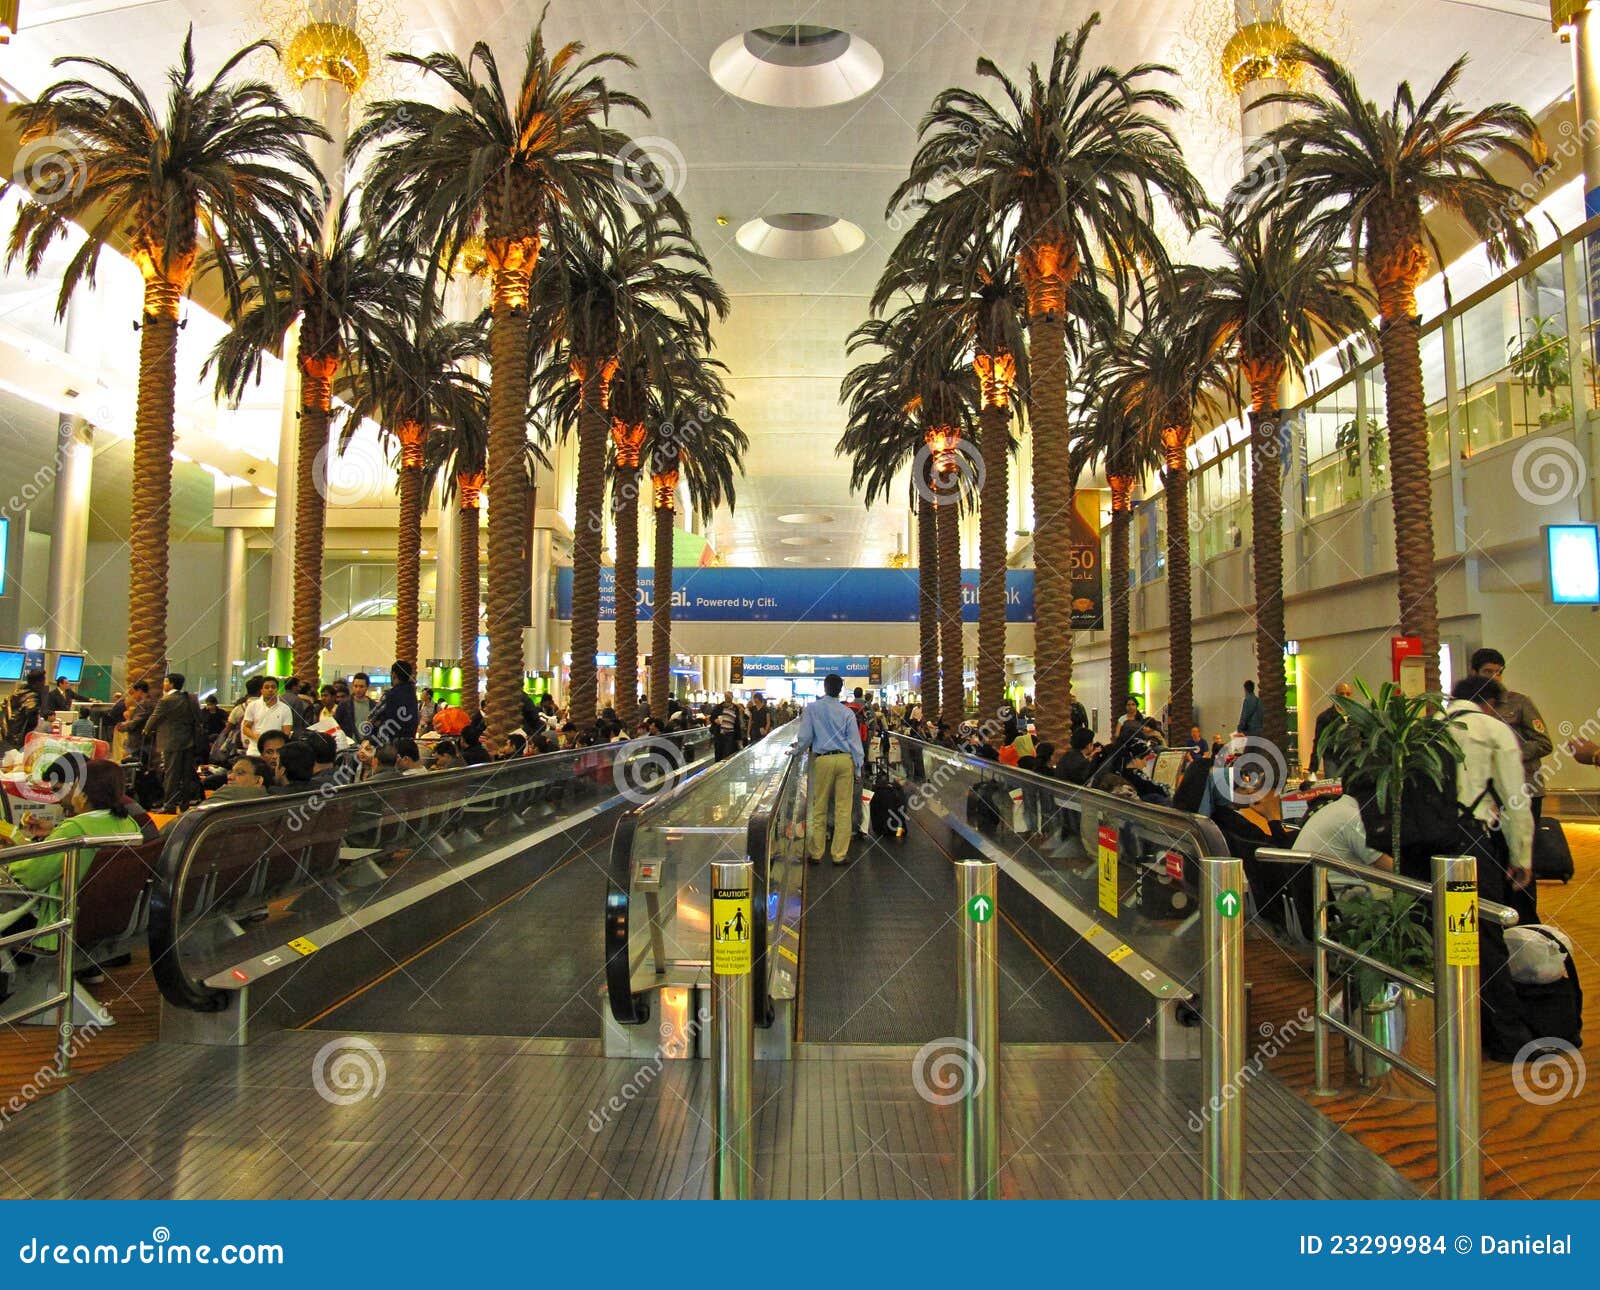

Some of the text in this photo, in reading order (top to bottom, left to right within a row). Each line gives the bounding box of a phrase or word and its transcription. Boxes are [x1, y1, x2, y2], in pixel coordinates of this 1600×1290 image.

[697, 598, 739, 607] Powered
[742, 598, 754, 609] by
[757, 598, 778, 607] Citi.
